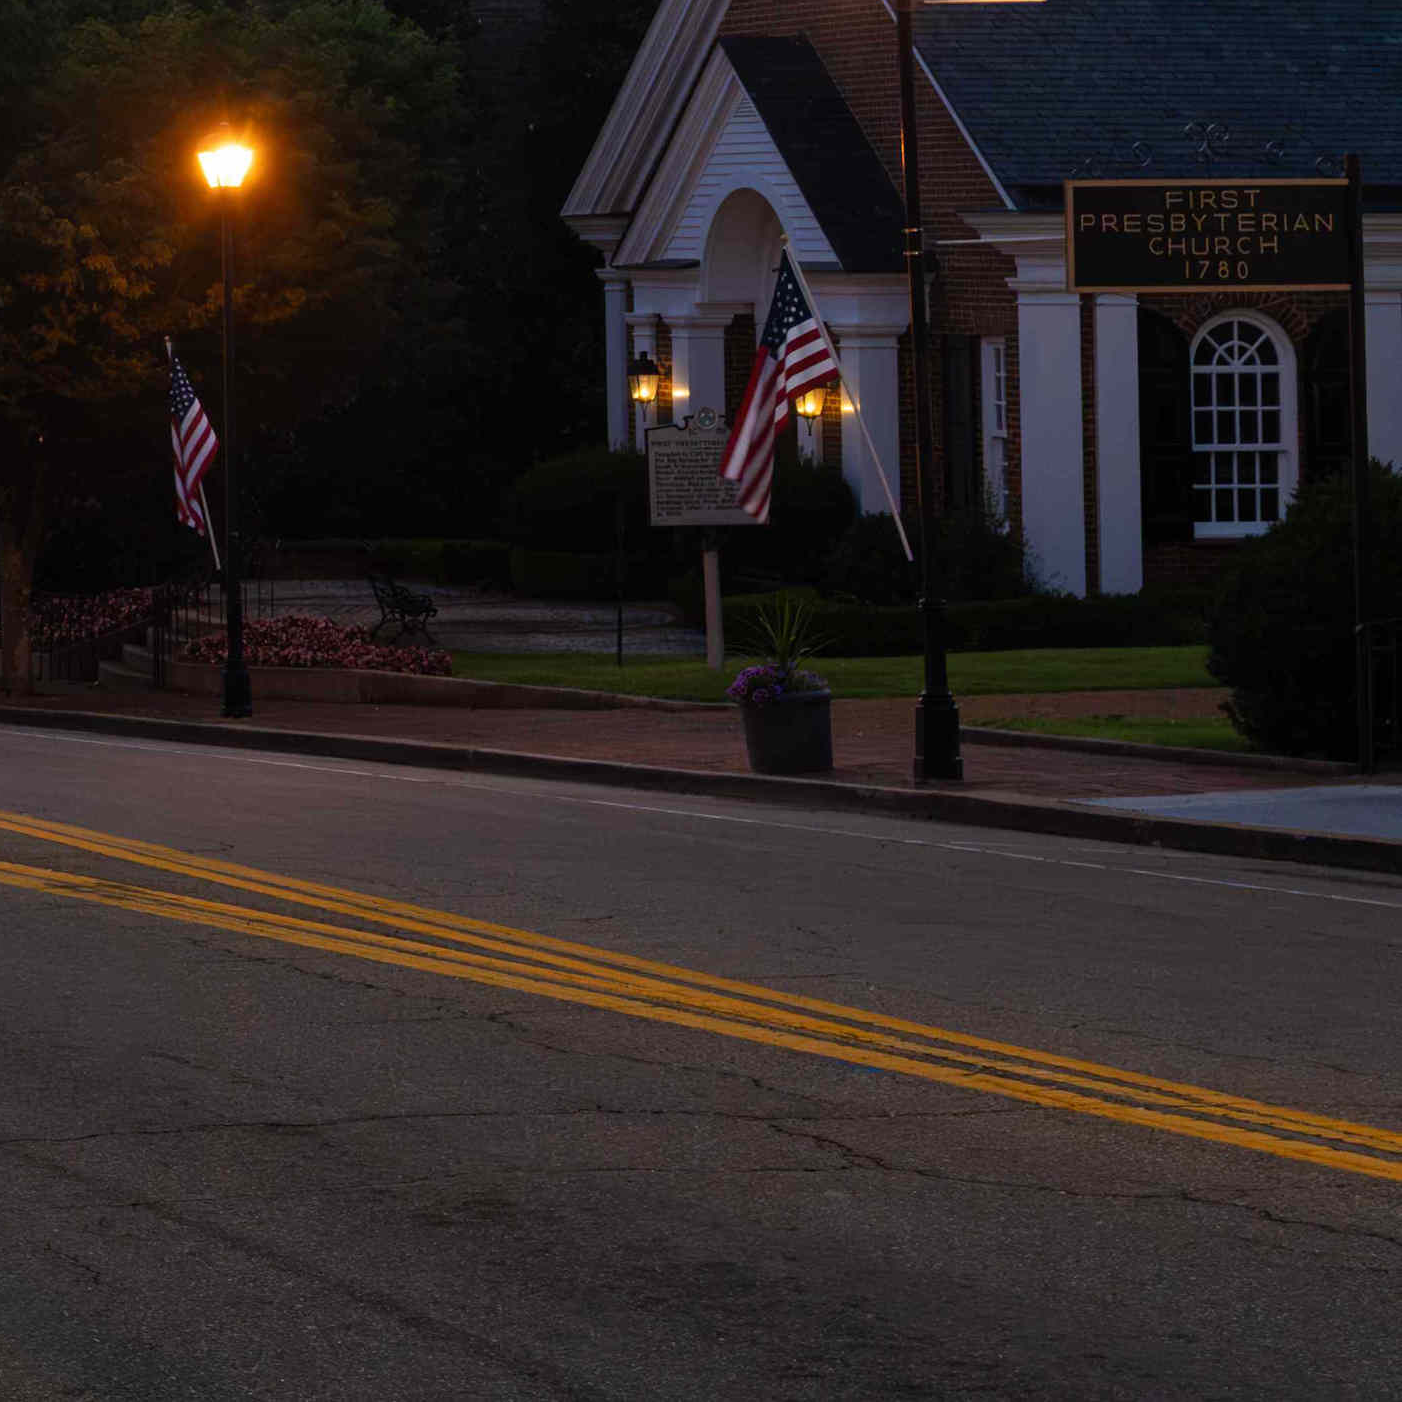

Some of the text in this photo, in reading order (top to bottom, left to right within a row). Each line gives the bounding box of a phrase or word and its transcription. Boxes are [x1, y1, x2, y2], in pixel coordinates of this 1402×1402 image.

[1165, 189, 1261, 210] FIRST
[1079, 212, 1334, 233] PRESBYTERIAN
[1148, 235, 1280, 255] CHURCH
[1183, 260, 1249, 279] 1780
